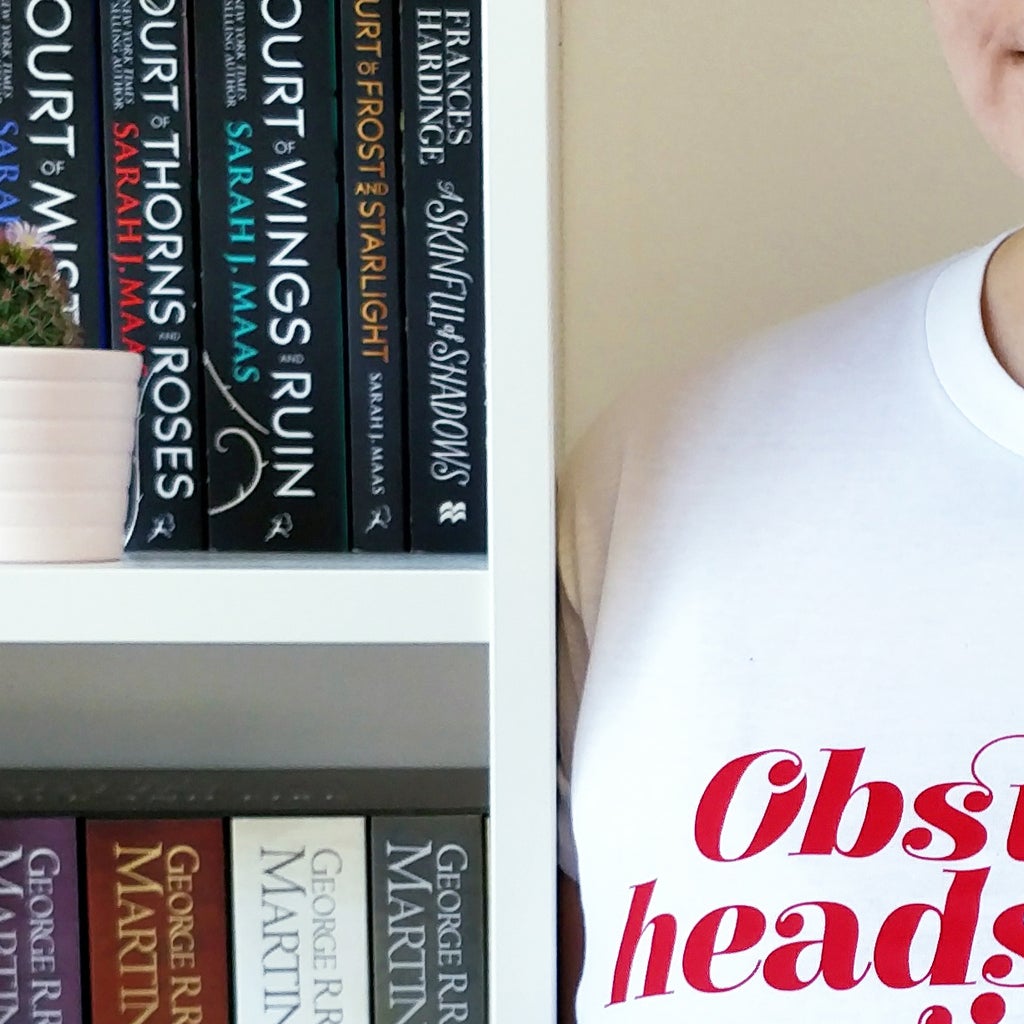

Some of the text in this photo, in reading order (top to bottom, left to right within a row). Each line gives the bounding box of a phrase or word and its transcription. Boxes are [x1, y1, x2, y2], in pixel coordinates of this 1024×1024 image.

[112, 55, 125, 111] AUTHOR
[122, 30, 134, 64] YORK
[123, 68, 135, 104] TIMES
[224, 53, 238, 109] AUTHOR
[234, 27, 246, 60] YORK
[236, 64, 248, 101] TIMES
[357, 61, 379, 76] OF
[414, 8, 446, 166] HARDINGE
[444, 8, 474, 147] FRANCES
[40, 160, 66, 176] OF
[150, 115, 170, 129] OF
[274, 140, 295, 155] OF
[356, 80, 387, 179] FROST
[142, 132, 187, 325] THORNS
[355, 182, 389, 196] AND
[110, 121, 149, 376] SARAH J. MAA
[222, 120, 261, 383] SARAH J. MAAS
[264, 159, 312, 346] WINGS
[358, 201, 390, 364] STARLIGHT
[424, 199, 474, 327] SKINFUL
[158, 332, 181, 341] AND
[280, 354, 304, 363] AND
[150, 347, 194, 500] ROSES
[269, 371, 315, 498] RUIN
[367, 371, 385, 429] SARAH
[428, 340, 473, 487] SHADOWS
[370, 446, 386, 495] MAAS
[28, 847, 61, 973] GEORGE
[166, 845, 200, 970] GEORGE
[311, 847, 344, 970] GEORGE
[435, 843, 469, 967] GEORGE
